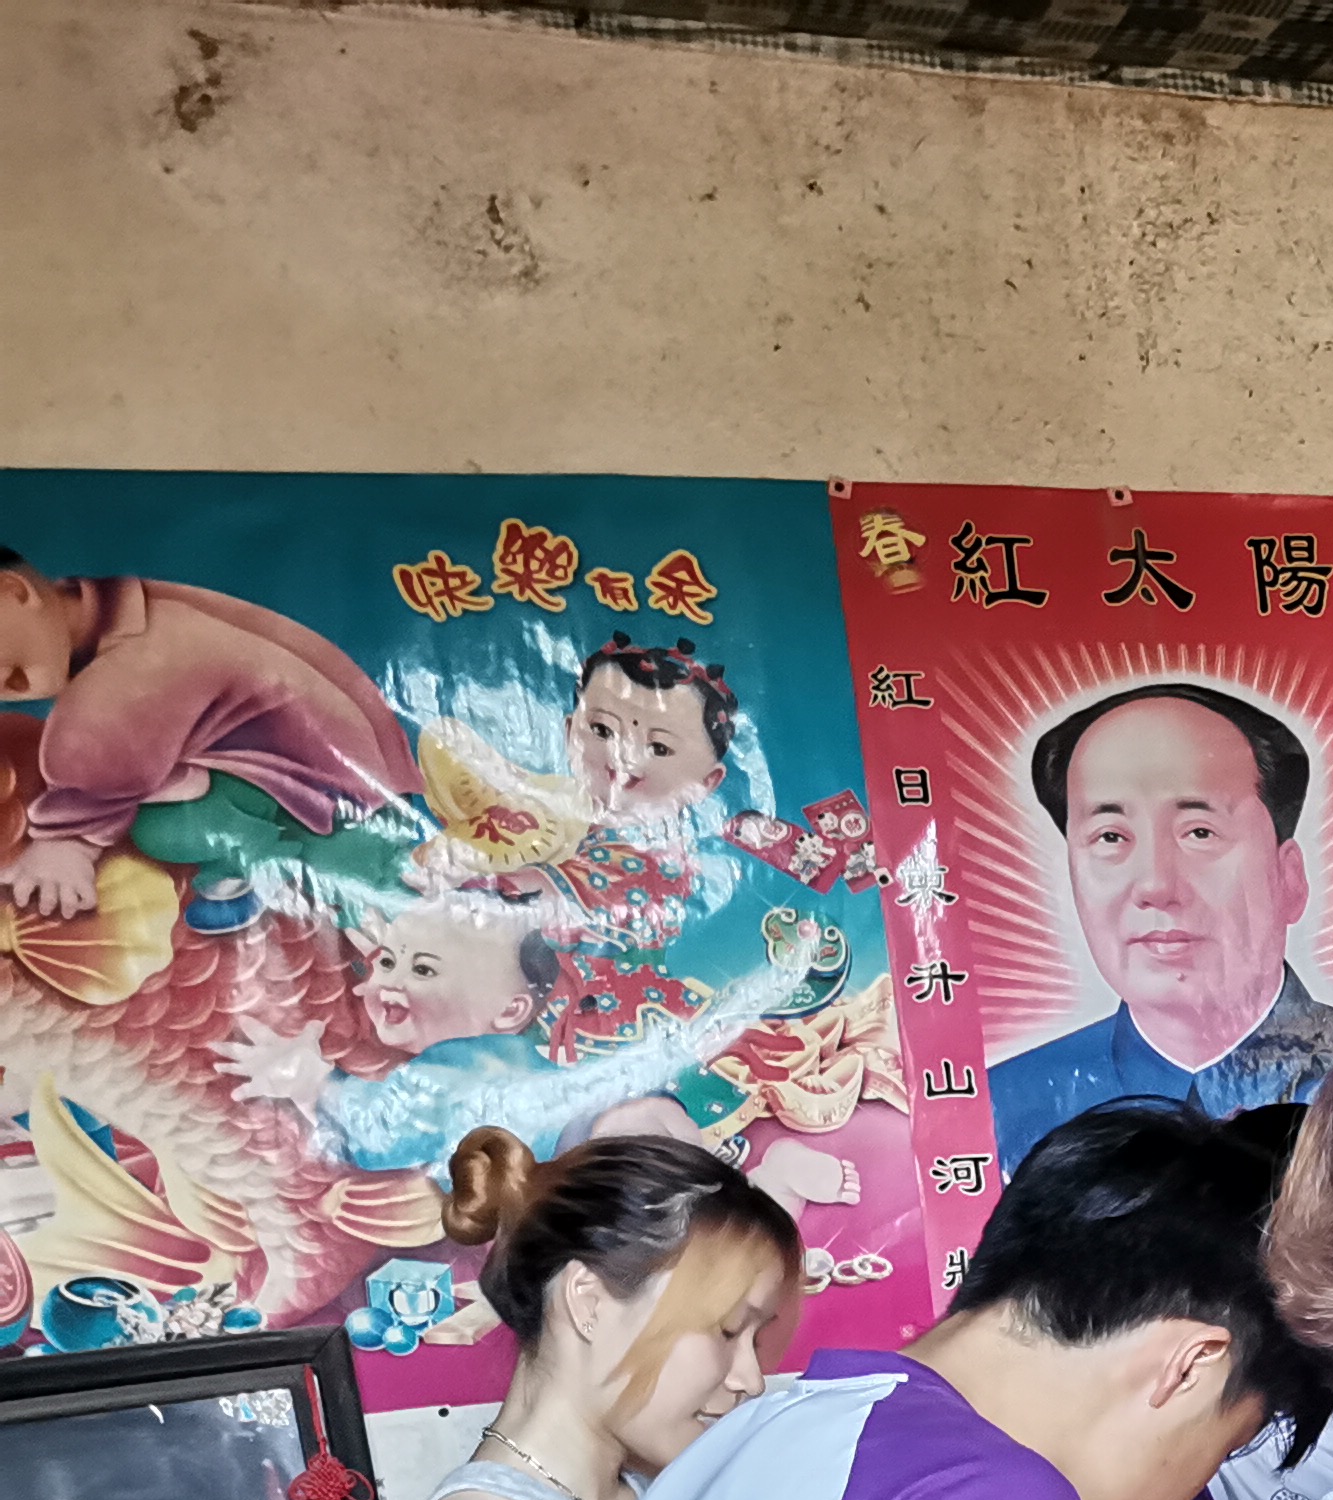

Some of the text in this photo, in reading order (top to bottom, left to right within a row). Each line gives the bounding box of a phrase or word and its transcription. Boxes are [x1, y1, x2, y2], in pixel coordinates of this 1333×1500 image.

[859, 509, 926, 565] 春
[949, 520, 1333, 616] 紅太陽
